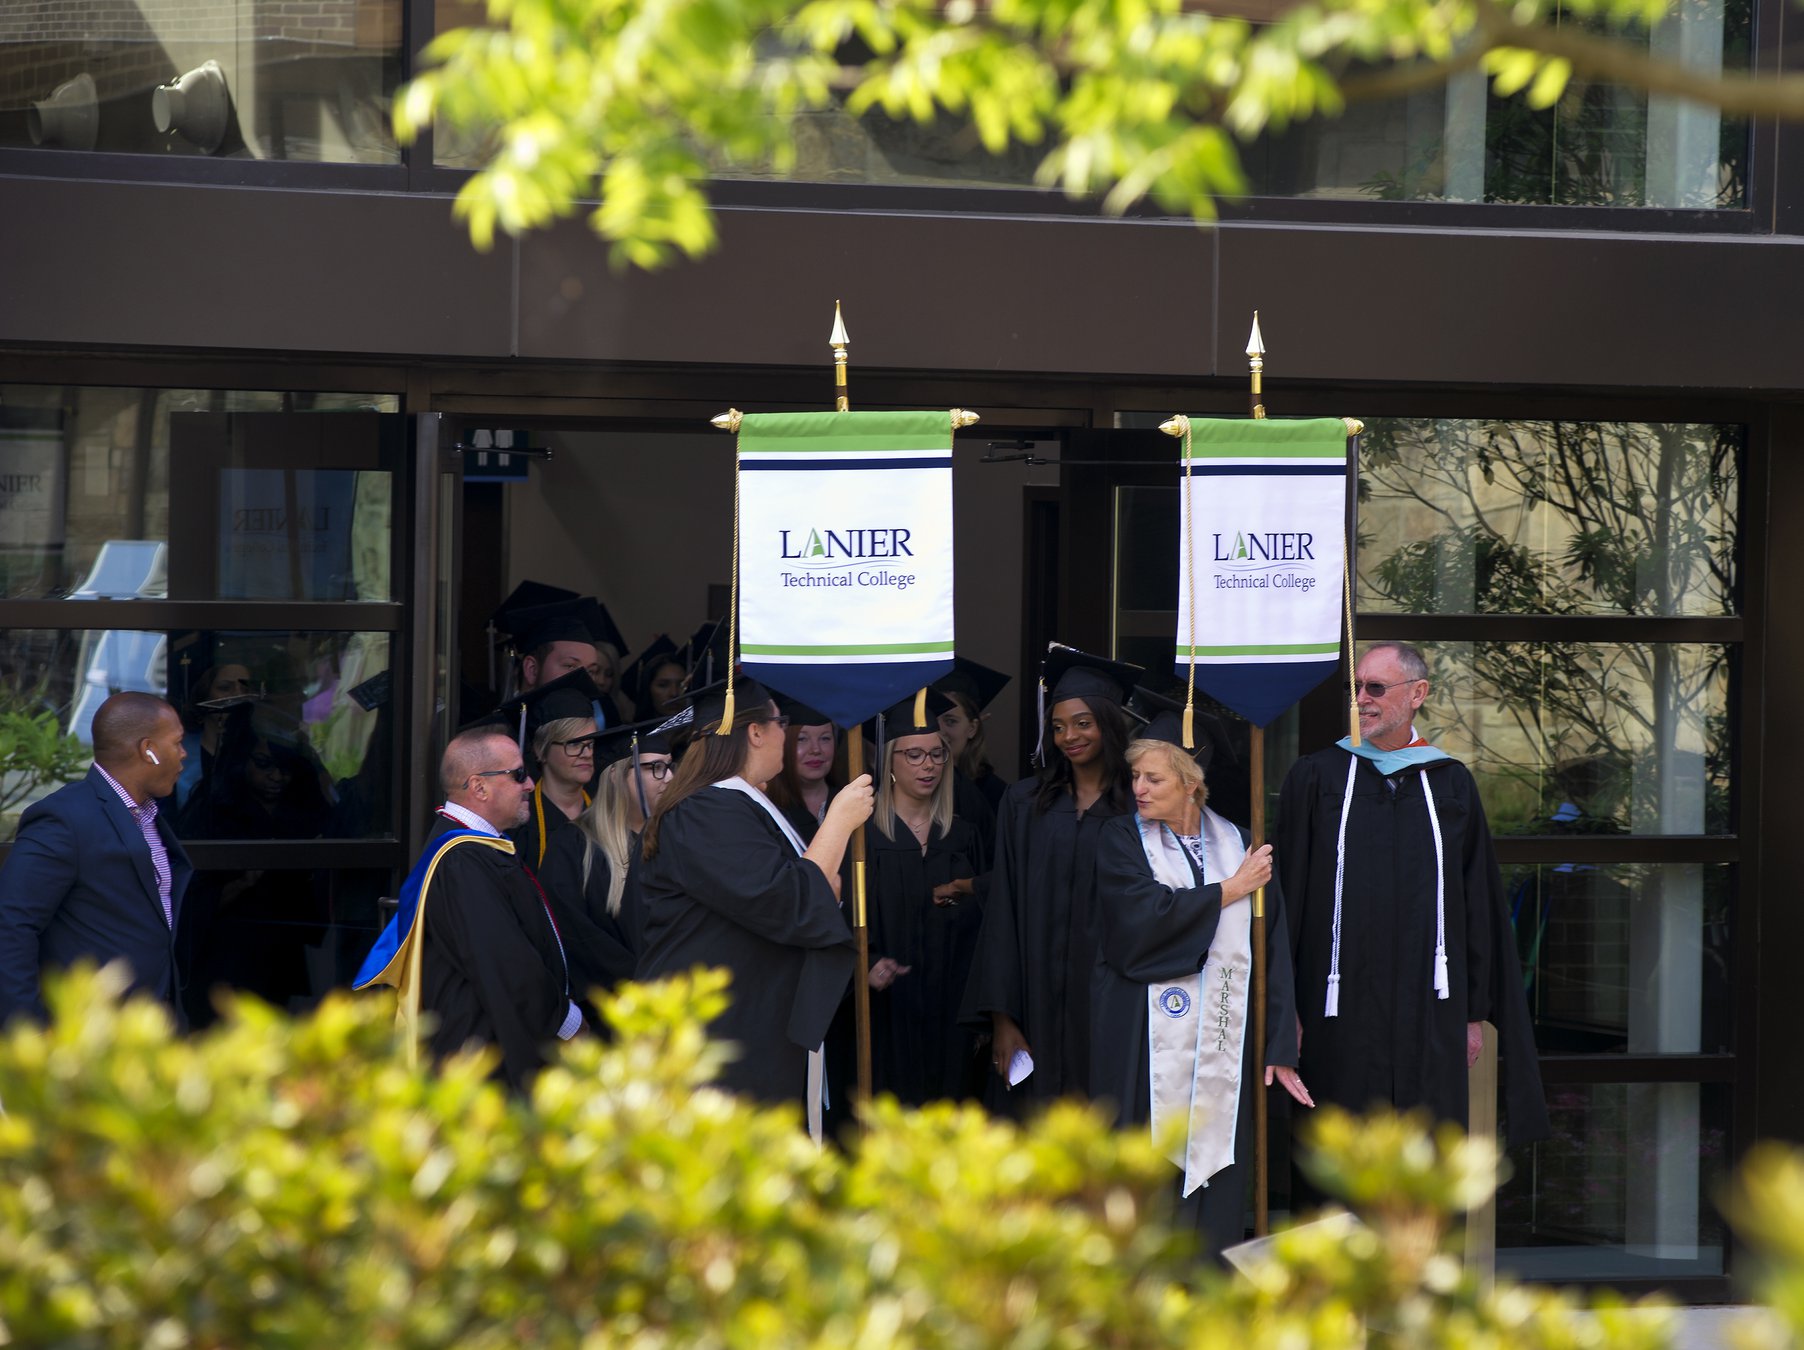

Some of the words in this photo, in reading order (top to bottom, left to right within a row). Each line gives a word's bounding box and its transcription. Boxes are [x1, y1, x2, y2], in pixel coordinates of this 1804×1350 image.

[778, 527, 914, 558] LANIER
[1212, 530, 1315, 561] LANIER
[780, 571, 853, 587] Technical
[857, 571, 916, 590] College
[1213, 574, 1269, 588] Technical
[1272, 573, 1316, 592] College
[1218, 967, 1233, 1052] MARSHAL
